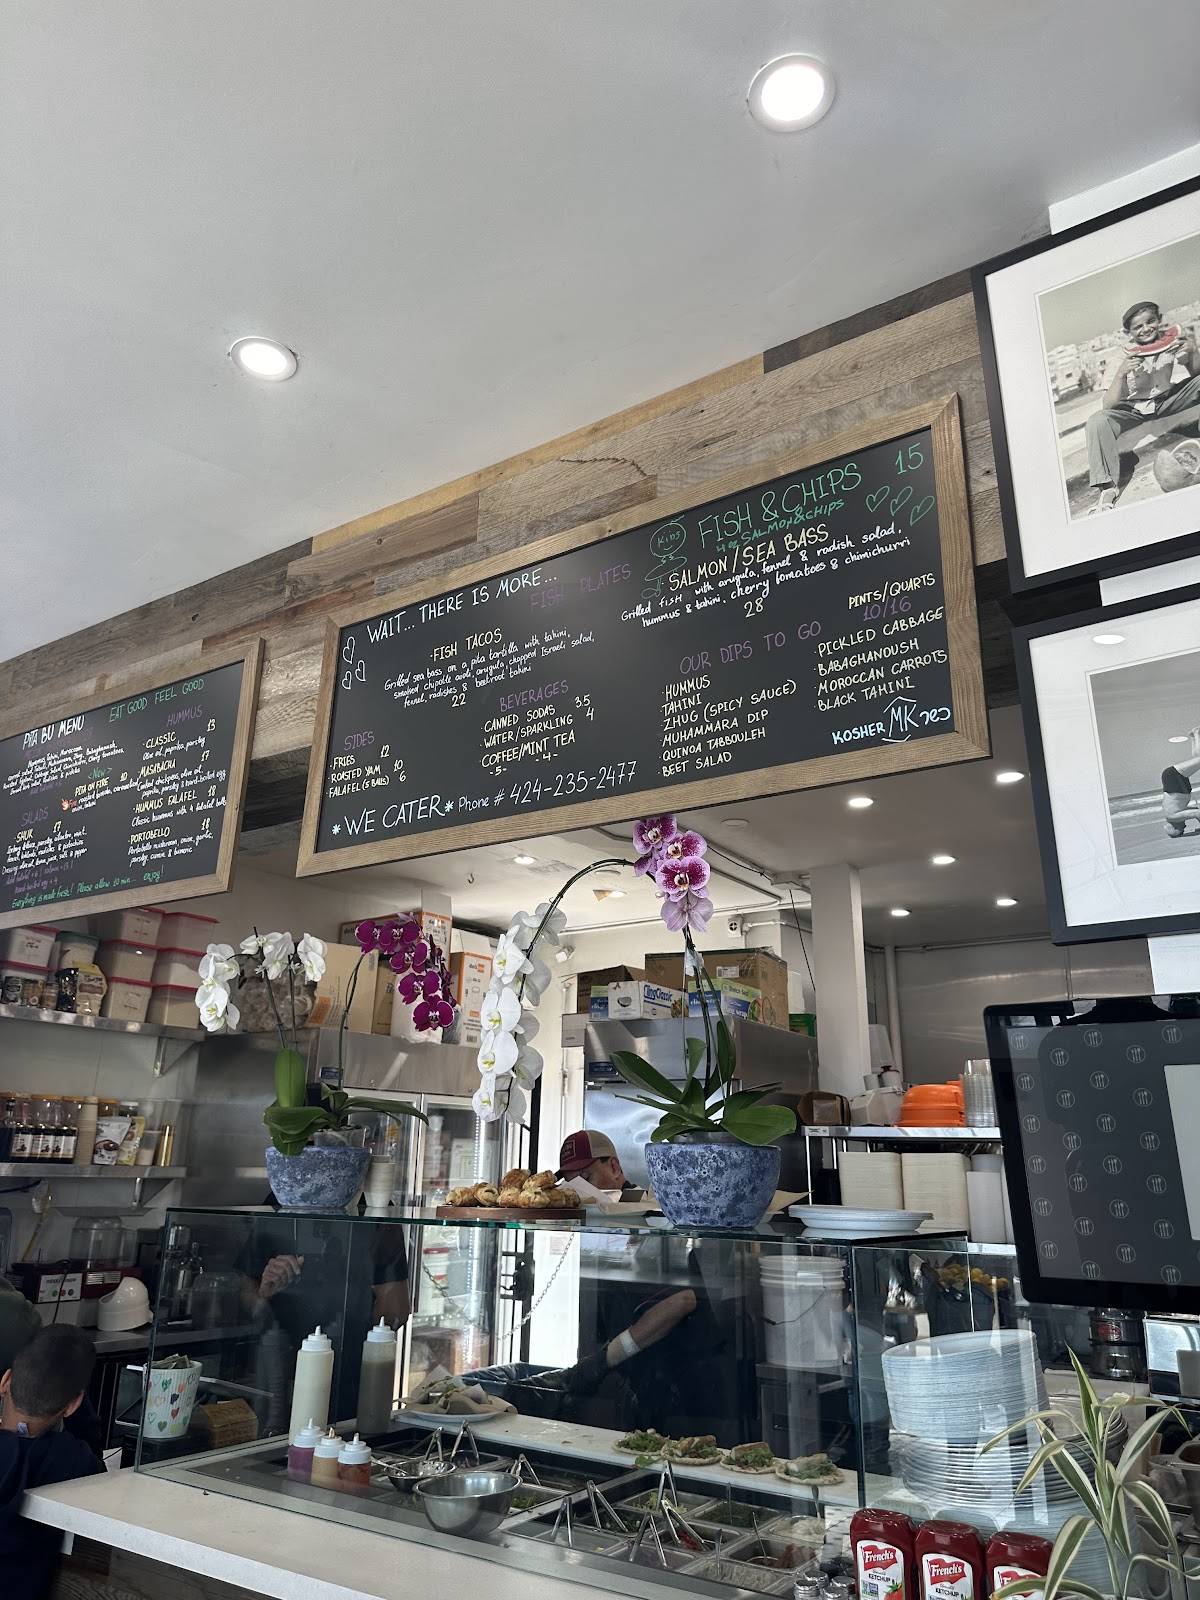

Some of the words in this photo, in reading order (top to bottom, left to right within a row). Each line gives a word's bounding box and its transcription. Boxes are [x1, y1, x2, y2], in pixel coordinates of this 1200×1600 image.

[698, 502, 752, 549] FISH
[895, 442, 924, 475] 15
[784, 523, 829, 551] BASS
[621, 601, 652, 621] Grilled
[695, 585, 714, 596] with
[718, 567, 760, 588] arugula,
[761, 554, 792, 575] fennel
[799, 550, 808, 563] &
[817, 534, 855, 557] radish
[642, 609, 680, 628] hummus
[685, 604, 692, 614] &
[731, 579, 770, 600] cherry
[775, 560, 826, 585] tomatoes
[830, 558, 838, 570] &
[844, 536, 910, 564] chimichurri
[849, 573, 936, 609] PINTS/QUARTS
[419, 593, 463, 624] THERE
[472, 587, 490, 605] IS
[744, 597, 764, 618] 28
[864, 595, 912, 621] 10/16
[433, 641, 458, 662] FISH
[466, 629, 502, 651] TACOS
[680, 651, 711, 674] OUR
[720, 641, 753, 663] DIPS
[763, 632, 786, 651] TO
[798, 621, 821, 640] GO
[818, 629, 876, 657] PICKLED
[883, 606, 944, 636] CABBAGE
[385, 672, 410, 691] Grilled
[413, 674, 425, 683] sea
[427, 668, 443, 678] bass
[448, 664, 457, 672] on
[471, 652, 486, 670] pita
[489, 642, 519, 661] tortilla
[525, 634, 540, 649] with
[424, 675, 452, 691] chipotle
[509, 648, 537, 665] chopped
[541, 641, 566, 657] Israeli
[817, 666, 885, 696] MOROCCAN
[891, 649, 948, 675] CARROTS
[818, 638, 919, 676] BABAGHANOUSH
[429, 687, 458, 700] radishes
[475, 672, 505, 688] beetroot
[509, 663, 532, 678] tahini
[500, 680, 569, 713] BEVERAGES
[665, 675, 710, 701] HUMMUS
[818, 692, 857, 711] BLACK
[861, 675, 915, 700] TAHINI
[109, 704, 125, 723] EAT
[127, 697, 148, 714] GOOD
[155, 687, 177, 704] FEEL
[182, 679, 204, 695] GOOD
[167, 705, 202, 727] HUMMUS
[451, 693, 466, 708] 22
[484, 714, 519, 733] CANNED
[527, 704, 555, 722] SODAS
[574, 694, 590, 708] 3.5
[662, 693, 702, 716] TAHINI
[663, 710, 699, 731] ZHUG
[703, 697, 743, 723] (SPICY
[751, 679, 797, 705] SAUCE)
[23, 729, 39, 750] PITA
[41, 724, 55, 744] BU
[58, 715, 85, 738] MENU
[145, 731, 176, 749] CLASSIC
[207, 719, 216, 732] 13
[344, 731, 375, 751] SIDES
[484, 714, 573, 748] WATER/SPARKLING
[586, 707, 594, 720] 4
[662, 718, 738, 747] MUHAMMARA
[747, 709, 769, 724] DIP
[832, 721, 885, 745] KOSHER
[888, 704, 919, 737] MK
[333, 755, 356, 770] FRIES
[380, 745, 390, 758] 12
[481, 737, 550, 768] COFFEE/MINT
[553, 729, 576, 747] TEA
[662, 742, 702, 762] QUINOA
[707, 727, 766, 751] TABBOULEH
[139, 759, 176, 779] MASABACHA
[201, 750, 210, 762] 17
[331, 767, 361, 784] ROASTED
[365, 765, 381, 777] YAM
[393, 759, 403, 772] 10
[662, 760, 689, 777] BEET
[695, 751, 732, 769] SALAD
[135, 797, 163, 814] HUMMUS
[168, 790, 198, 806] FALAFEL
[208, 785, 217, 797] 18
[329, 782, 361, 798] FALAFEL
[399, 770, 406, 782] 6
[458, 796, 490, 813] Phone
[494, 788, 505, 806] #
[509, 760, 637, 805] 424-235-2477
[130, 826, 171, 845] PORTOBELLO
[201, 817, 211, 831] 18
[864, 1549, 894, 1563] French's
[930, 1563, 963, 1577] French's
[868, 1573, 891, 1582] KETCHUP
[935, 1587, 959, 1597] KETCHUP
